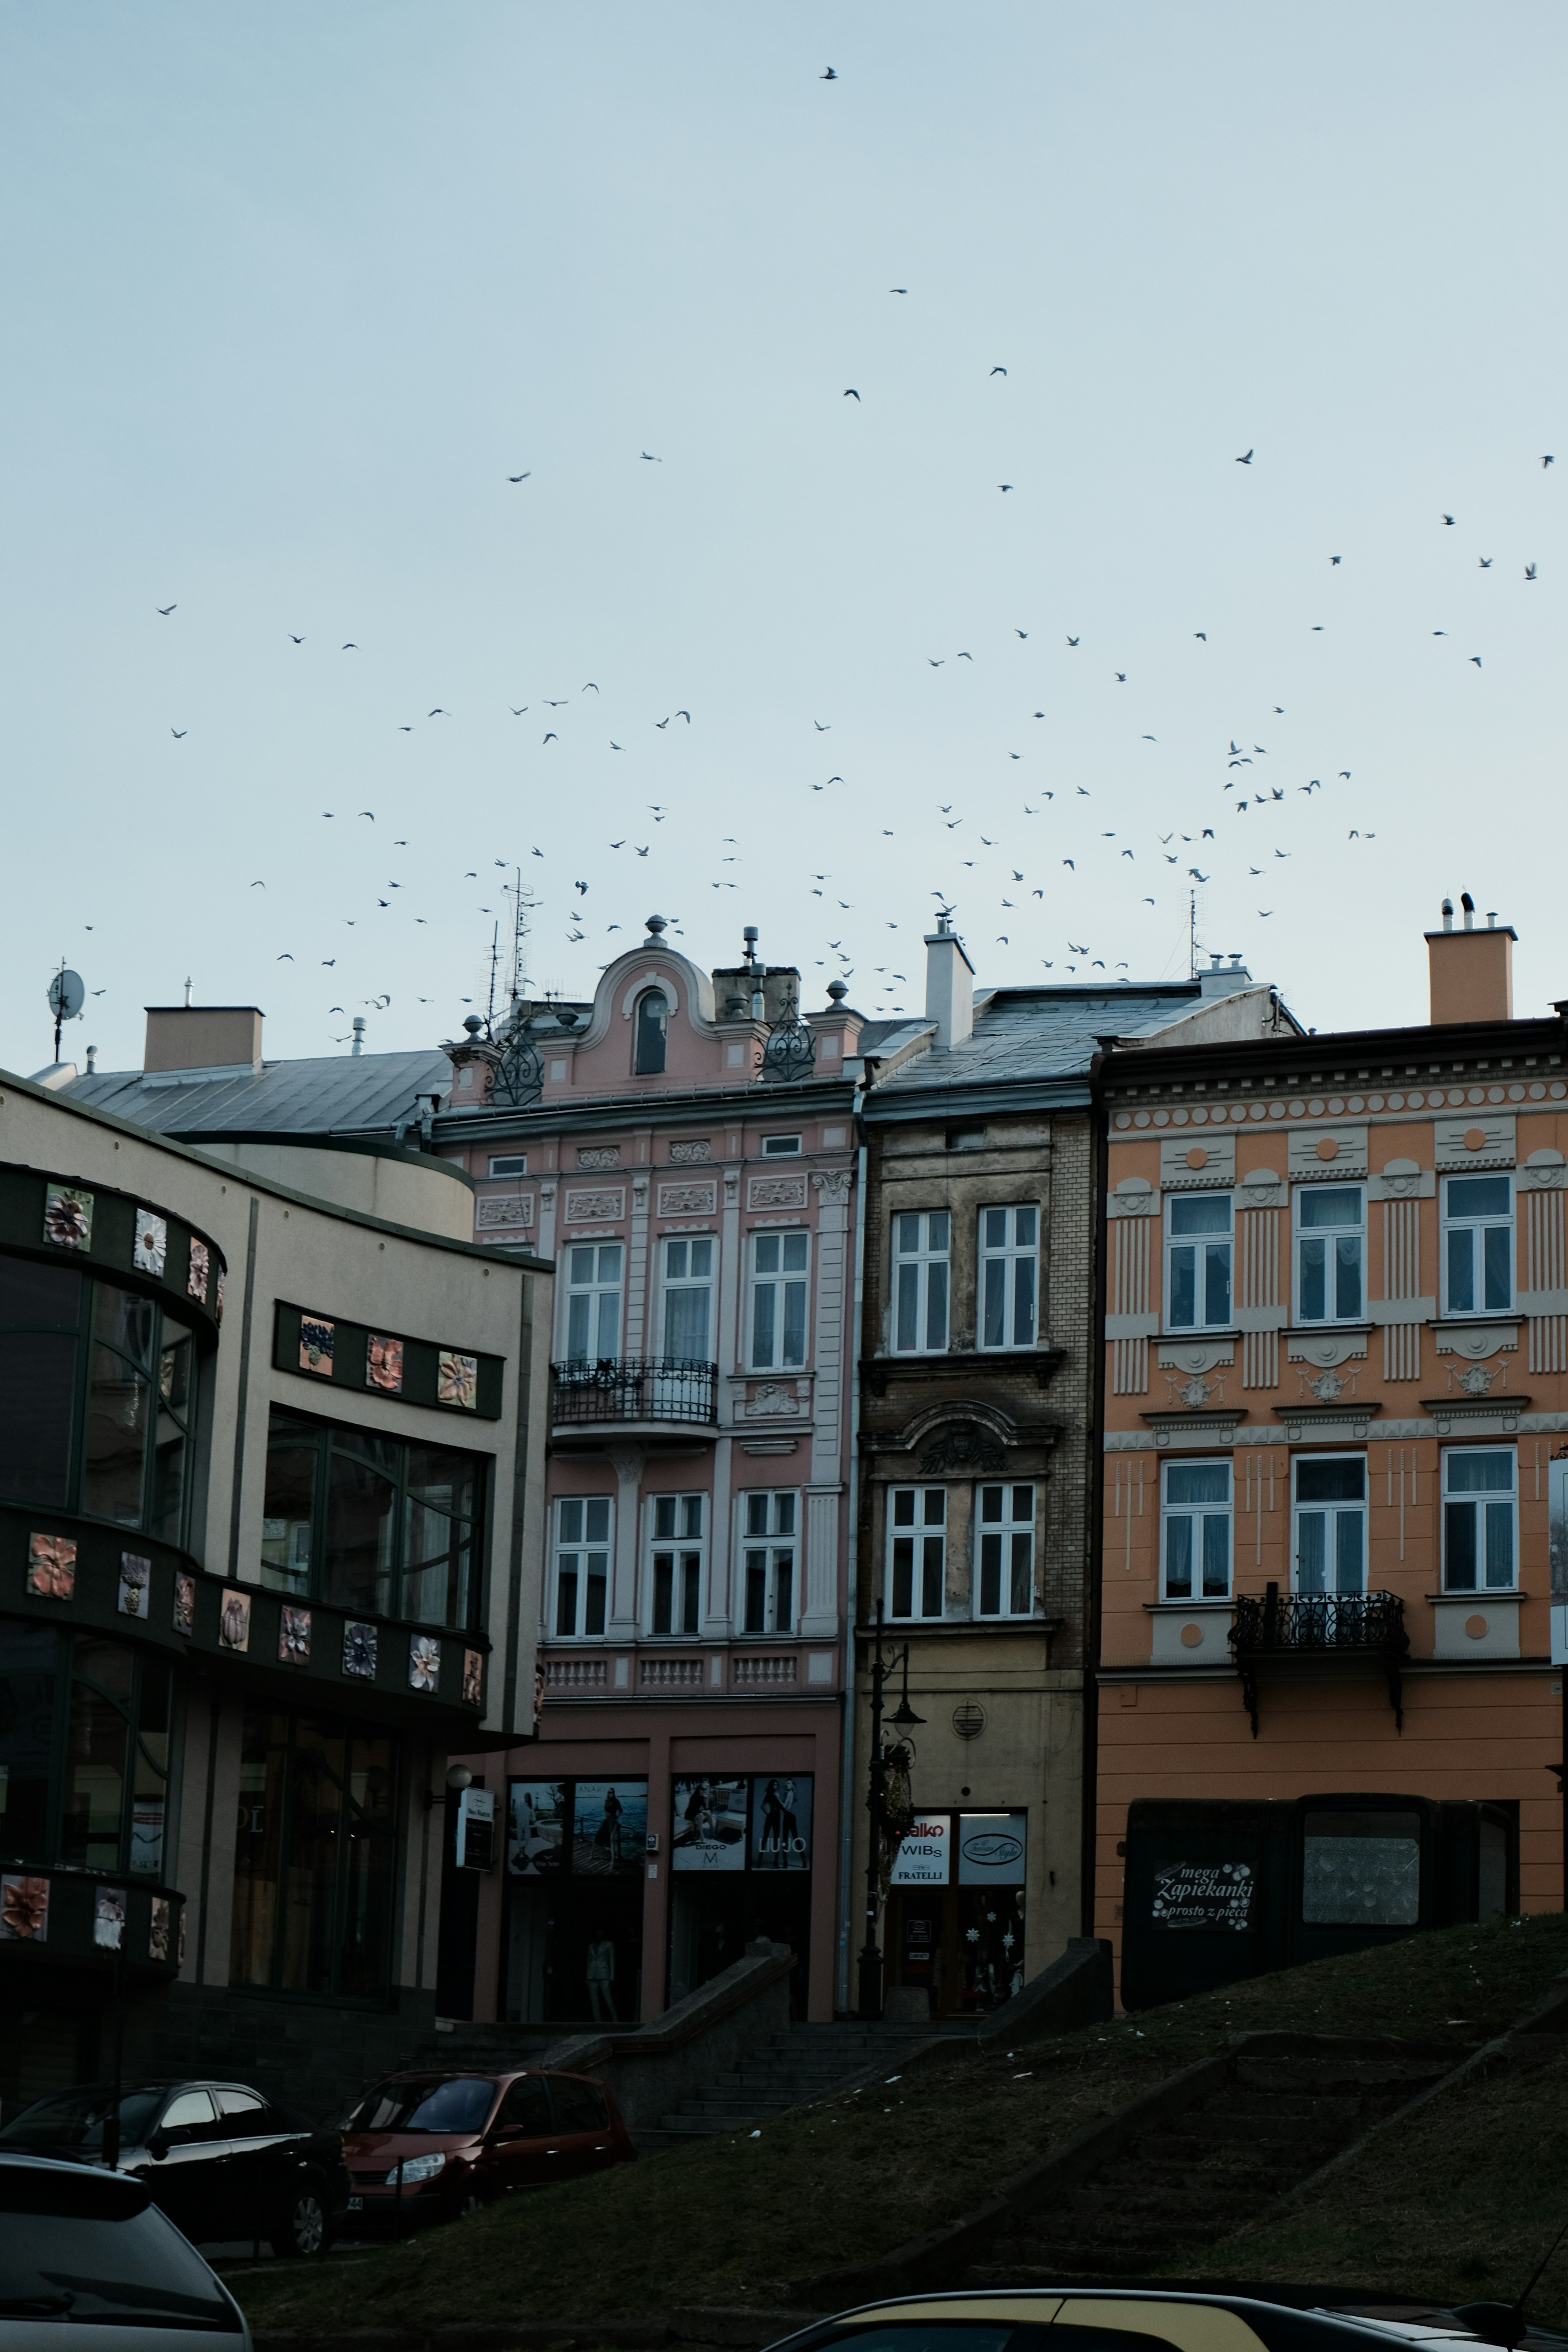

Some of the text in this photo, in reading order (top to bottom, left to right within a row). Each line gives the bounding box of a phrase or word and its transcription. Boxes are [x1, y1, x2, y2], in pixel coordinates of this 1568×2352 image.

[906, 1823, 943, 1837] alko
[703, 1852, 718, 1863] M
[1180, 1868, 1220, 1884] mega
[1157, 1878, 1254, 1902] Zapiekanki
[1166, 1905, 1248, 1921] prosto z pieca
